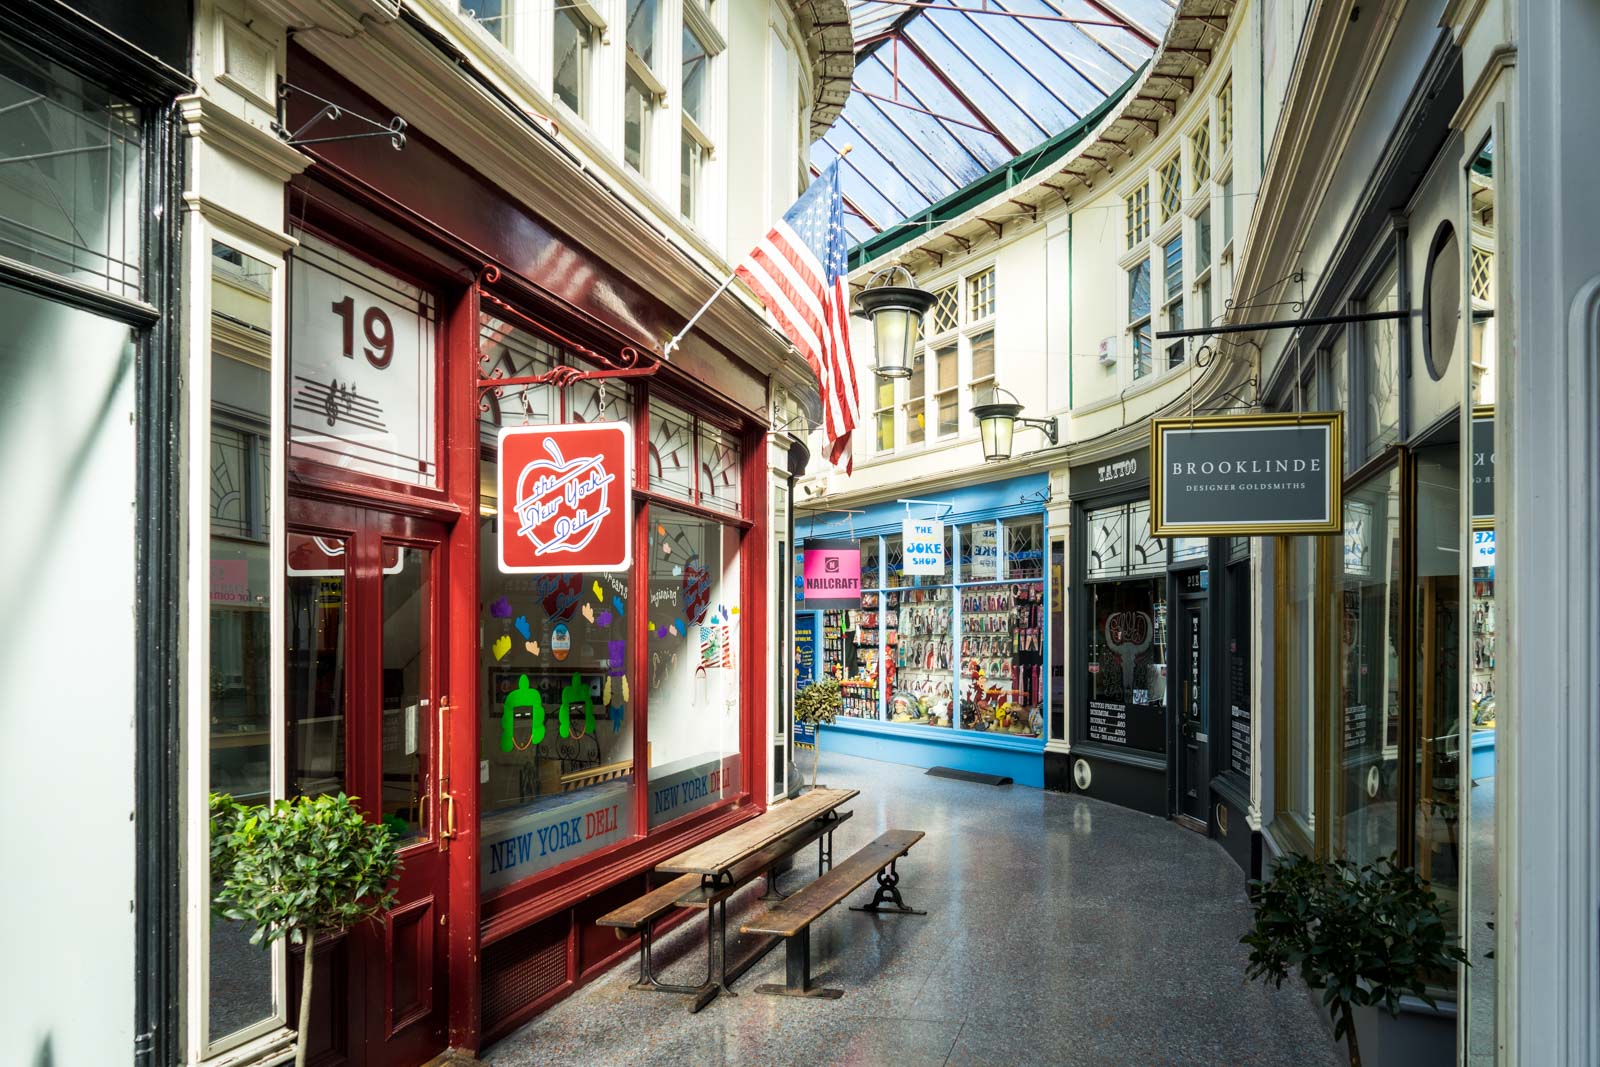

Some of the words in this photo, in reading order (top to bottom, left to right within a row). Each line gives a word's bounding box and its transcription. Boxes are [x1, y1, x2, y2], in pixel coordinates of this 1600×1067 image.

[331, 295, 394, 370] 19
[1098, 458, 1137, 482] TATTOO
[1172, 459, 1321, 475] BROOKLINDE
[533, 474, 558, 497] the
[1186, 484, 1236, 492] DESIGNER
[1238, 482, 1306, 491] GOLDSMITHS
[519, 496, 563, 531] New
[565, 470, 604, 509] York
[914, 526, 933, 534] THE
[906, 543, 942, 554] JOKE
[912, 557, 937, 566] SHOP
[806, 577, 859, 590] NAILCRAFT
[654, 784, 680, 814] NEW
[681, 775, 708, 804] YORK
[710, 768, 731, 793] DELI
[489, 831, 533, 874] NEW
[536, 816, 583, 857] YORK
[585, 805, 618, 840] DELI
